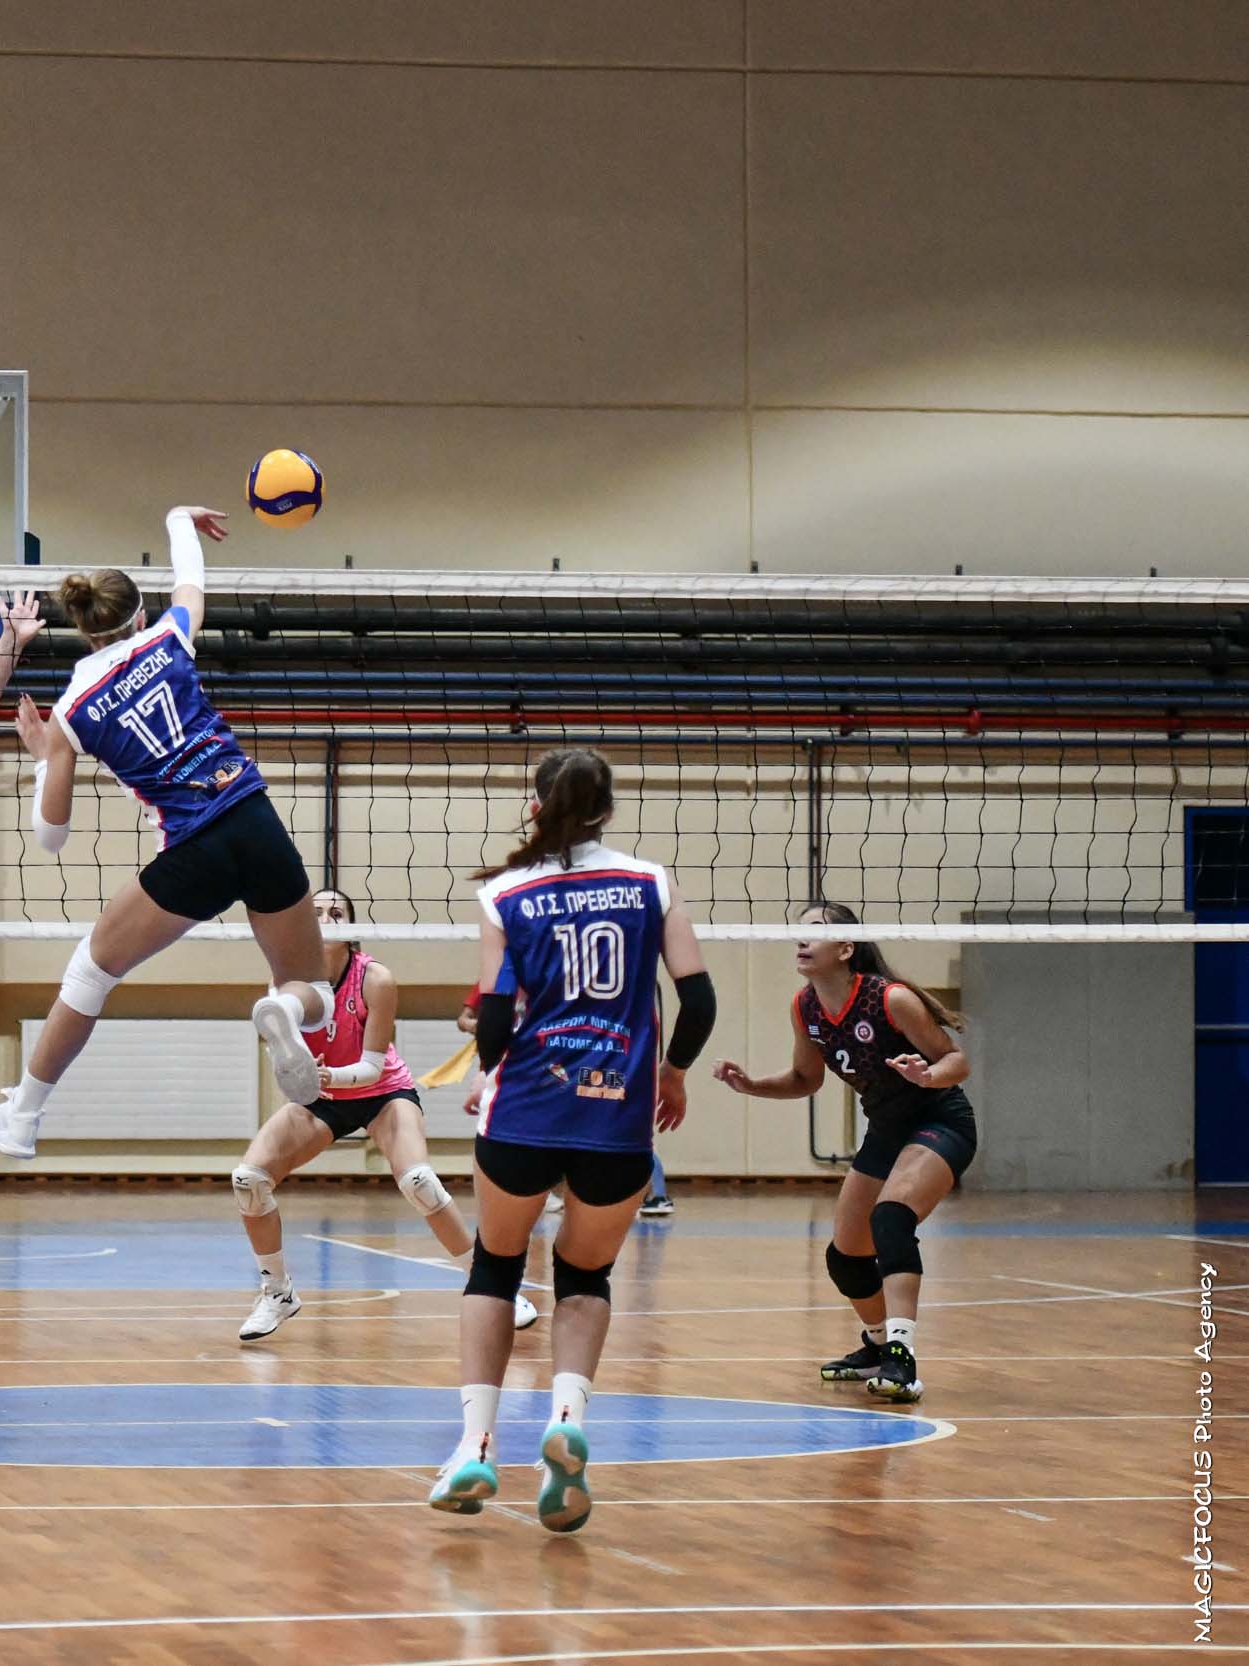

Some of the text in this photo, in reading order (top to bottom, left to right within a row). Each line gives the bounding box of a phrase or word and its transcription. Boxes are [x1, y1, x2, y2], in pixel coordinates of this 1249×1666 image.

[114, 647, 174, 702] ΠΡΕΒΕΖΗΣ
[118, 679, 186, 760] 17
[520, 886, 645, 919] Φ.Γ.Σ. ΠΡΕΒΕΖΗΣ
[553, 920, 625, 1001] 10
[836, 1049, 856, 1074] 2
